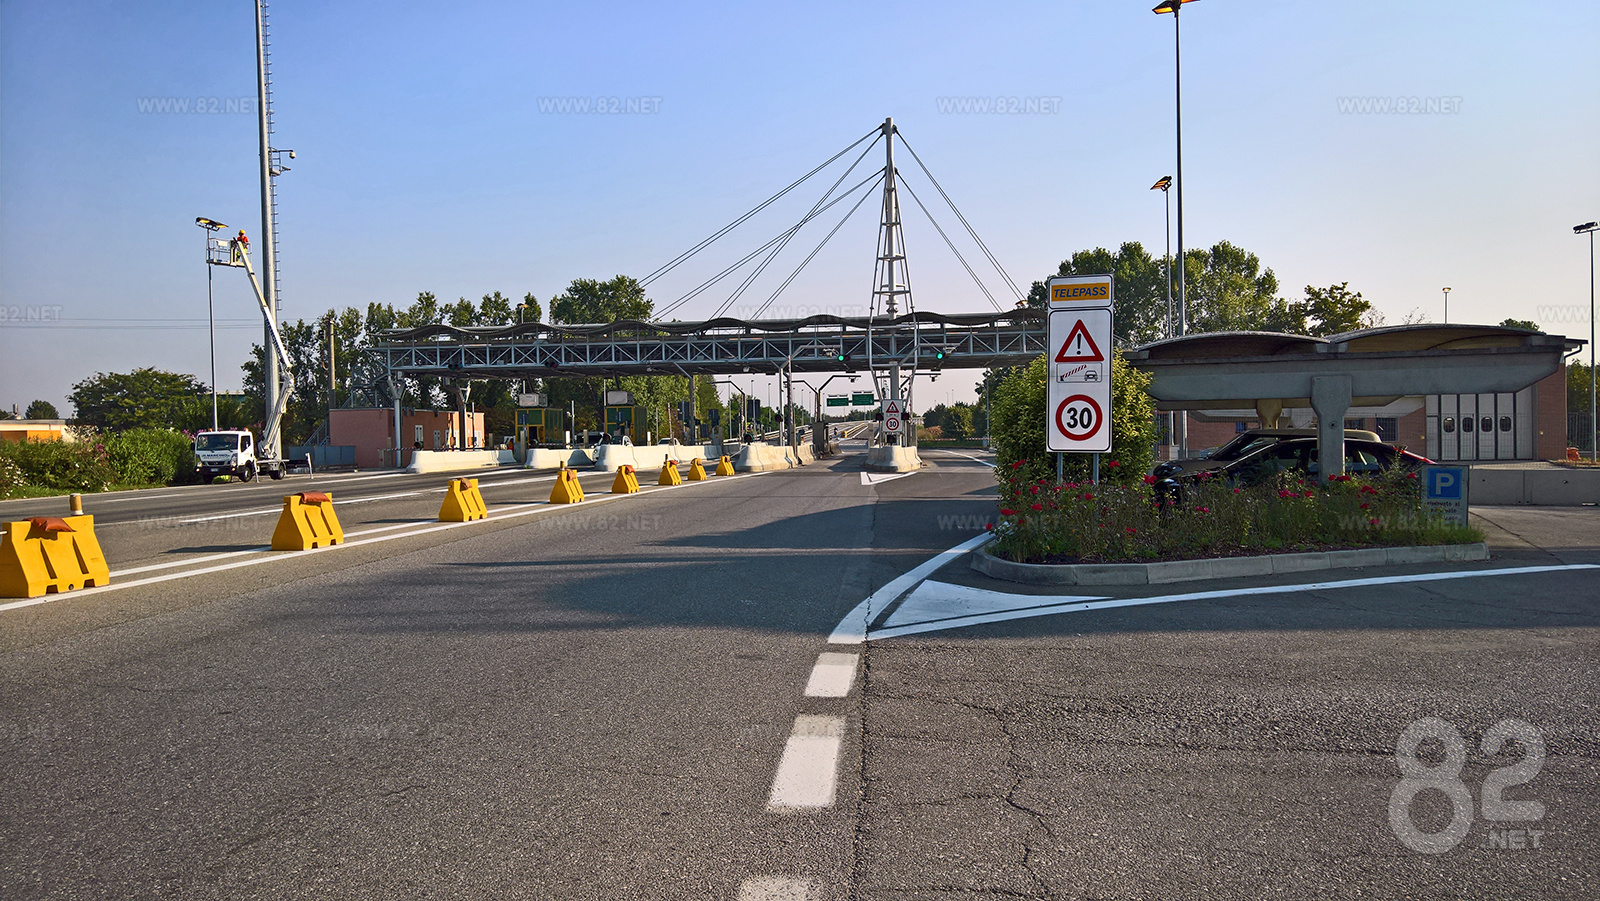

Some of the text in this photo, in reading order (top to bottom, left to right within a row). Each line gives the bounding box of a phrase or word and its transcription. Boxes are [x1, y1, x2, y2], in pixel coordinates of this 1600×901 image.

[1054, 286, 1107, 298] TELEPASS
[1066, 407, 1092, 429] 30
[1435, 472, 1454, 495] P
